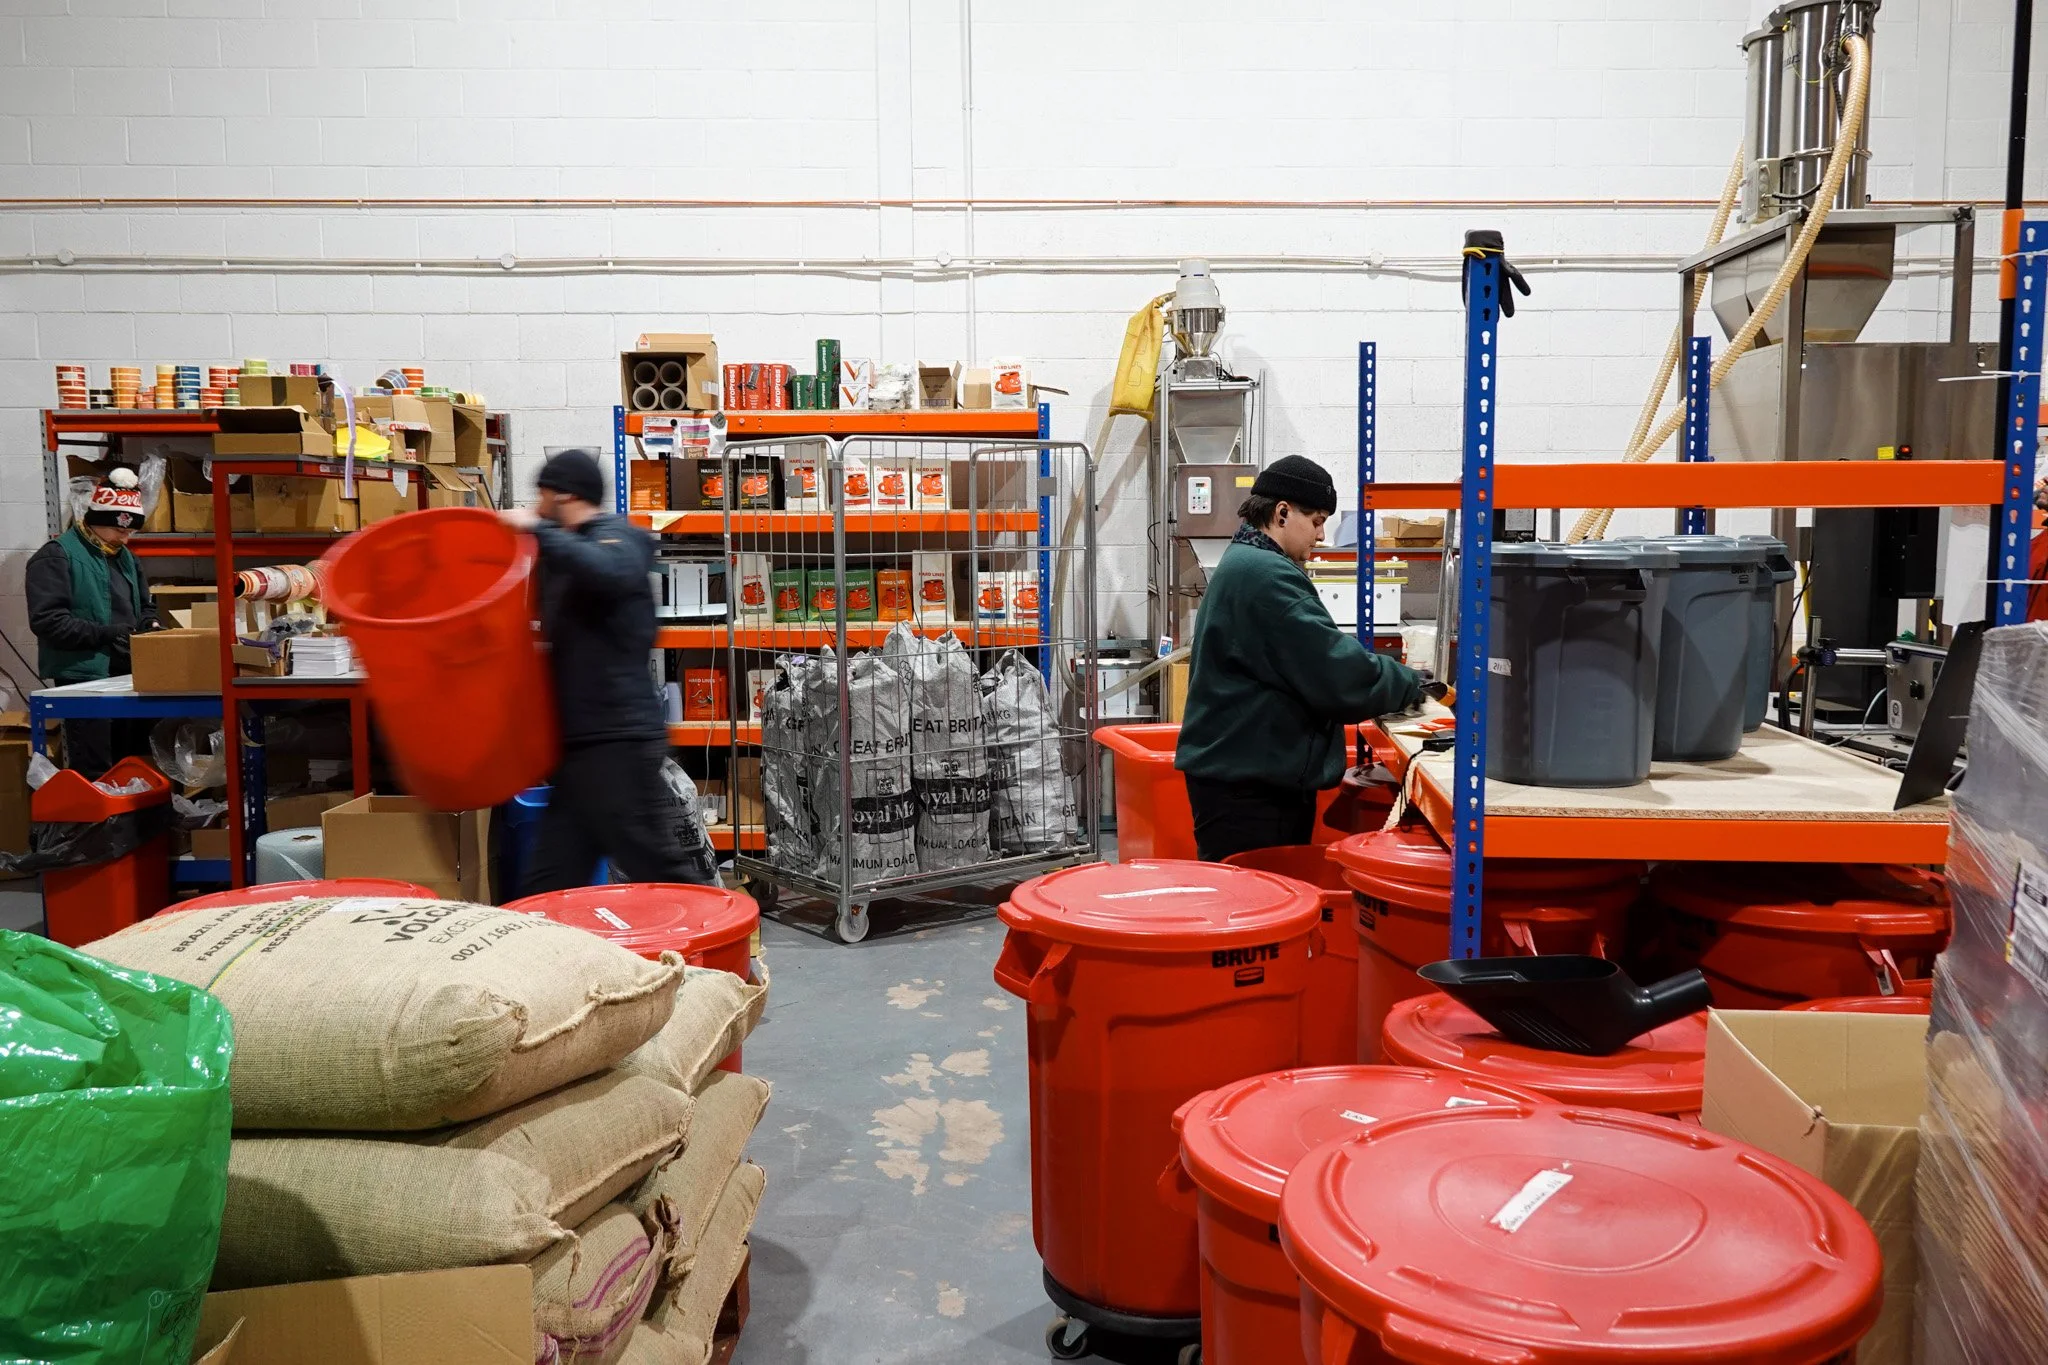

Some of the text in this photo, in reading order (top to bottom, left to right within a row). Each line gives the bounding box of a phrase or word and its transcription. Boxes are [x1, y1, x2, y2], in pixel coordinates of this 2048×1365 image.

[886, 852, 916, 869] LOAD
[171, 921, 220, 953] BRAZIL
[196, 923, 253, 962] FAZENDA
[450, 943, 484, 962] 002
[488, 922, 523, 940] 1643
[1212, 942, 1280, 968] BRUTE
